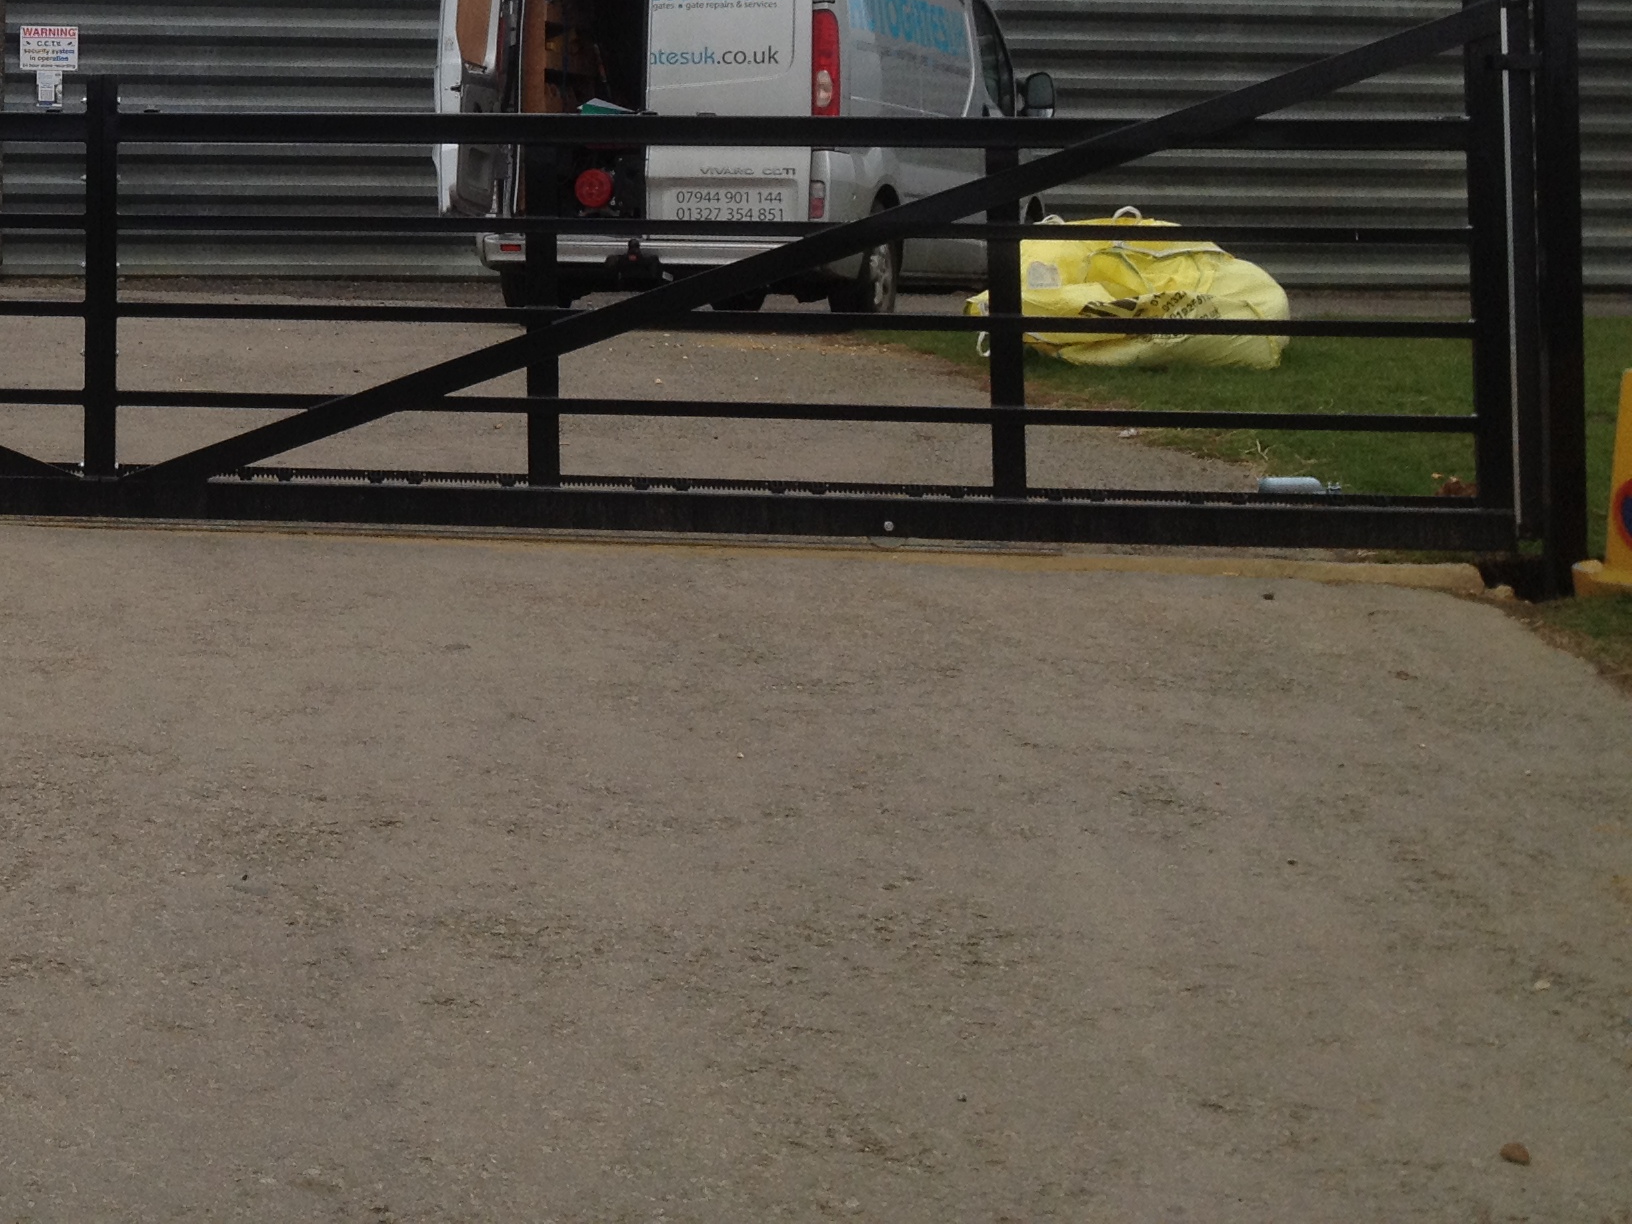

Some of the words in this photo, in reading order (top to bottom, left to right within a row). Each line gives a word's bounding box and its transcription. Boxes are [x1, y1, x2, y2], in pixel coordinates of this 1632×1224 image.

[685, 1, 704, 11] gate
[706, 1, 735, 10] repairs
[22, 28, 76, 37] WARNING
[37, 55, 69, 63] operation
[700, 167, 754, 175] VIVARO
[676, 191, 721, 203] 07944
[724, 191, 749, 203] 901
[757, 191, 782, 203] 144
[676, 207, 721, 220] 01327
[726, 207, 753, 221] 354
[757, 208, 784, 221] 851
